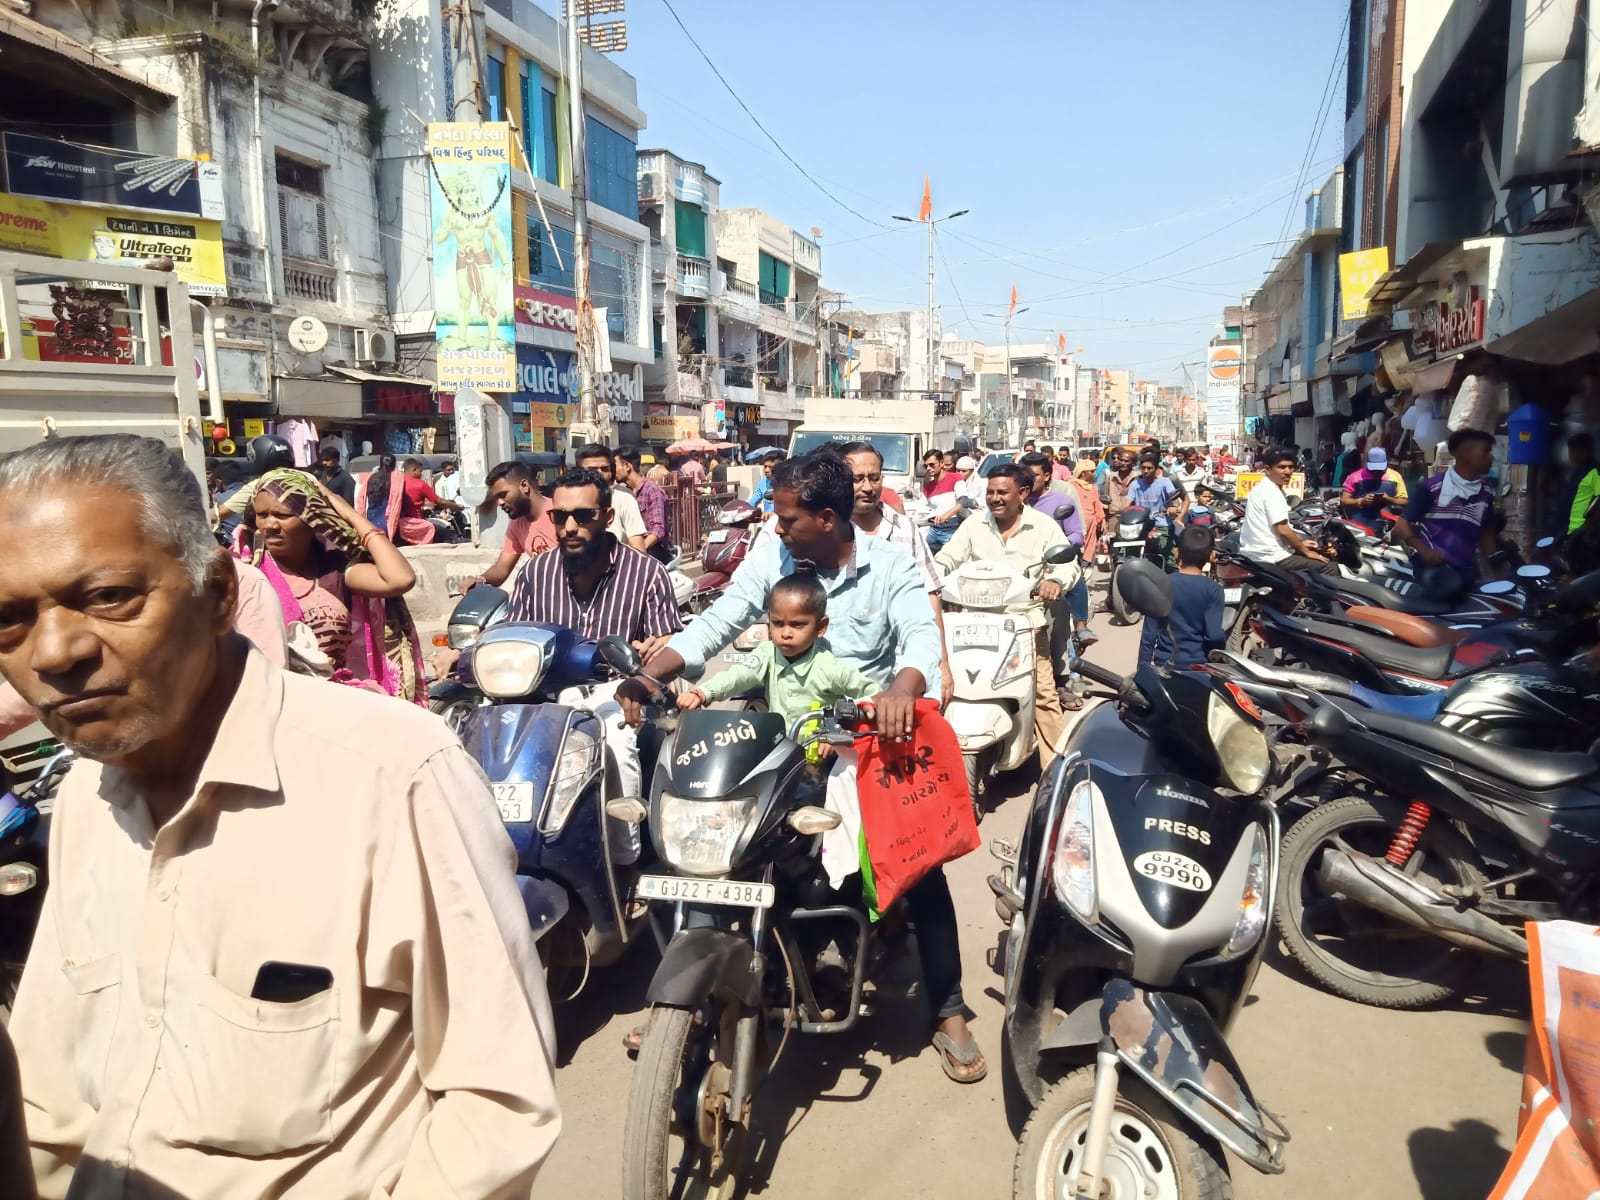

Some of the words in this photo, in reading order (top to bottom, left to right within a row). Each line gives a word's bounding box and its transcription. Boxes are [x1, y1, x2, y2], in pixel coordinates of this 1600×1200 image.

[24, 155, 57, 169] JSW
[120, 238, 192, 256] UltraTech
[1208, 379, 1241, 388] IndianO
[713, 719, 757, 747] અંબે
[493, 785, 516, 801] 22
[1156, 788, 1210, 809] HONDA
[1144, 817, 1212, 846] PRESS
[1143, 862, 1205, 890] 9990
[722, 886, 763, 903] 4384
